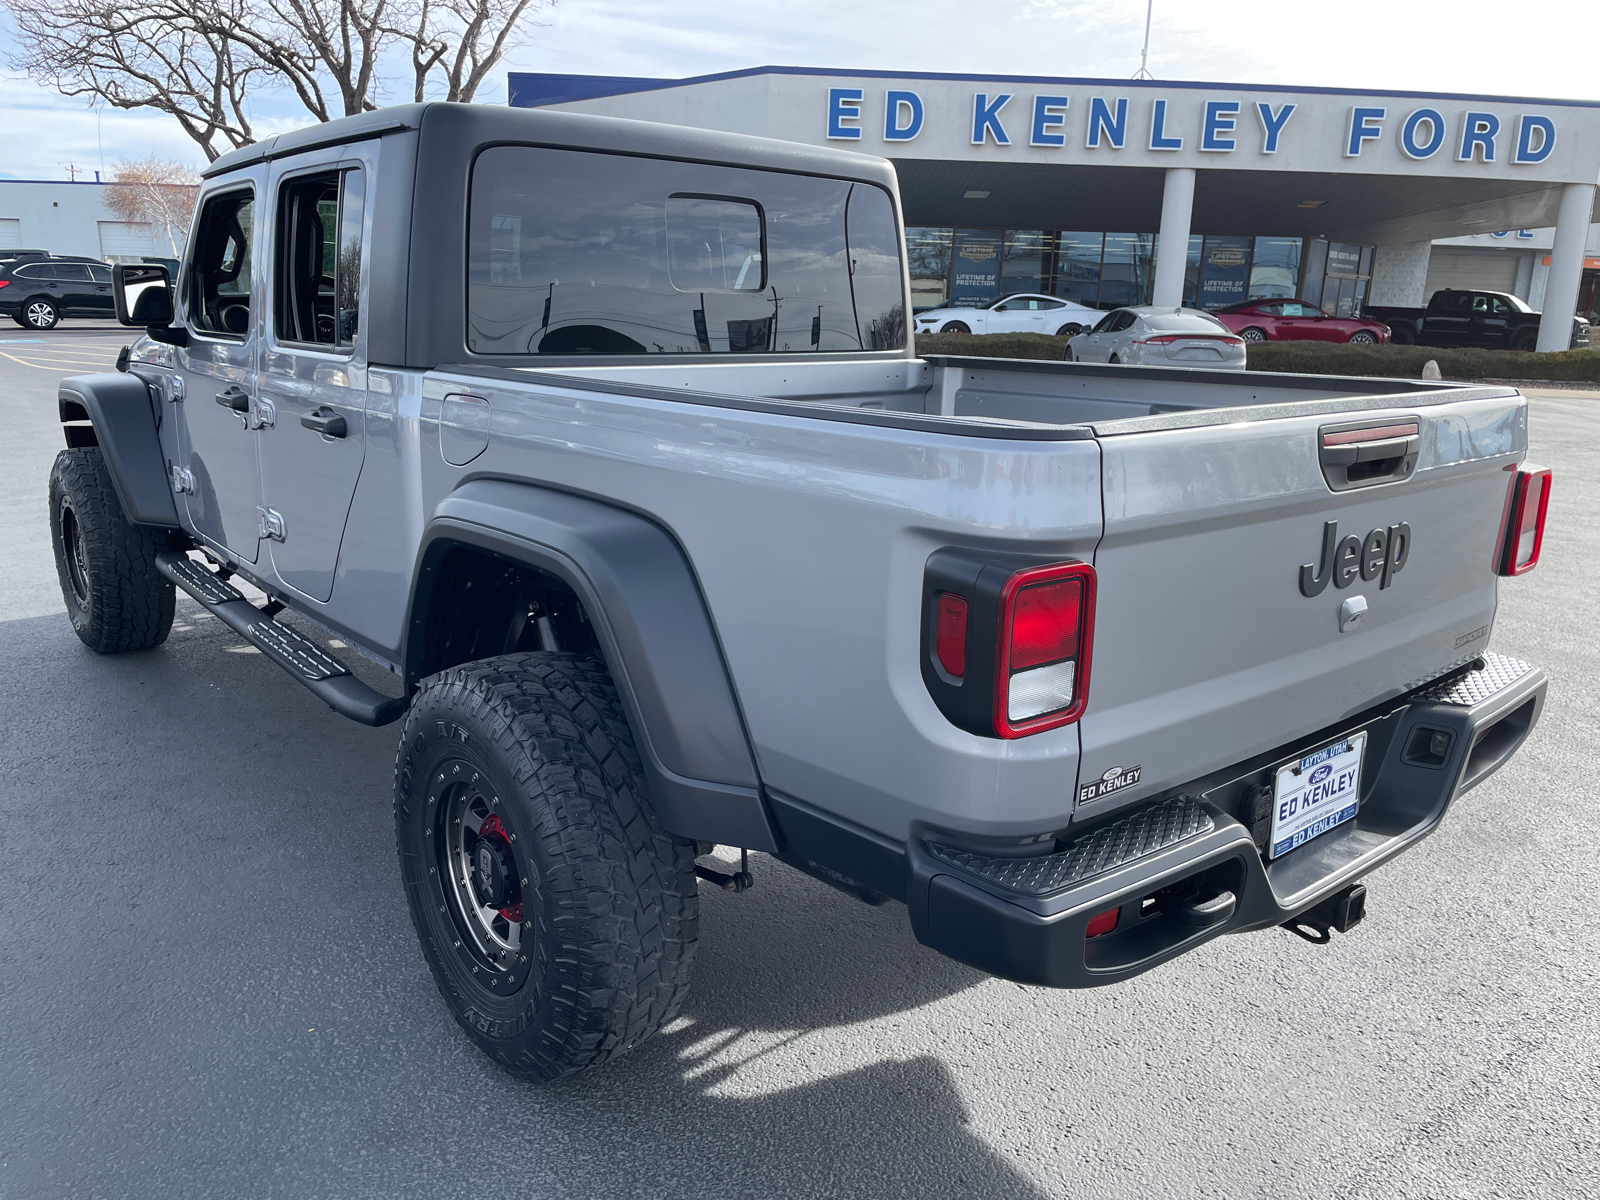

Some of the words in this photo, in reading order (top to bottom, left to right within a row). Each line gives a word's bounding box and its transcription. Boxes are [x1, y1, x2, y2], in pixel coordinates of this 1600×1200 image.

[825, 86, 926, 142] ED
[970, 91, 1298, 155] KENLEY
[1344, 105, 1559, 165] FORD
[1298, 520, 1411, 598] Jeep
[1456, 628, 1488, 647] SPORT
[1330, 741, 1348, 758] UTAH
[1080, 785, 1096, 801] ED
[1099, 769, 1141, 795] KENLEY
[1313, 768, 1329, 784] Ford
[1279, 796, 1298, 822] ED
[1302, 769, 1356, 810] KENLEY
[1292, 830, 1305, 848] ED
[1306, 811, 1342, 840] KENLEY
